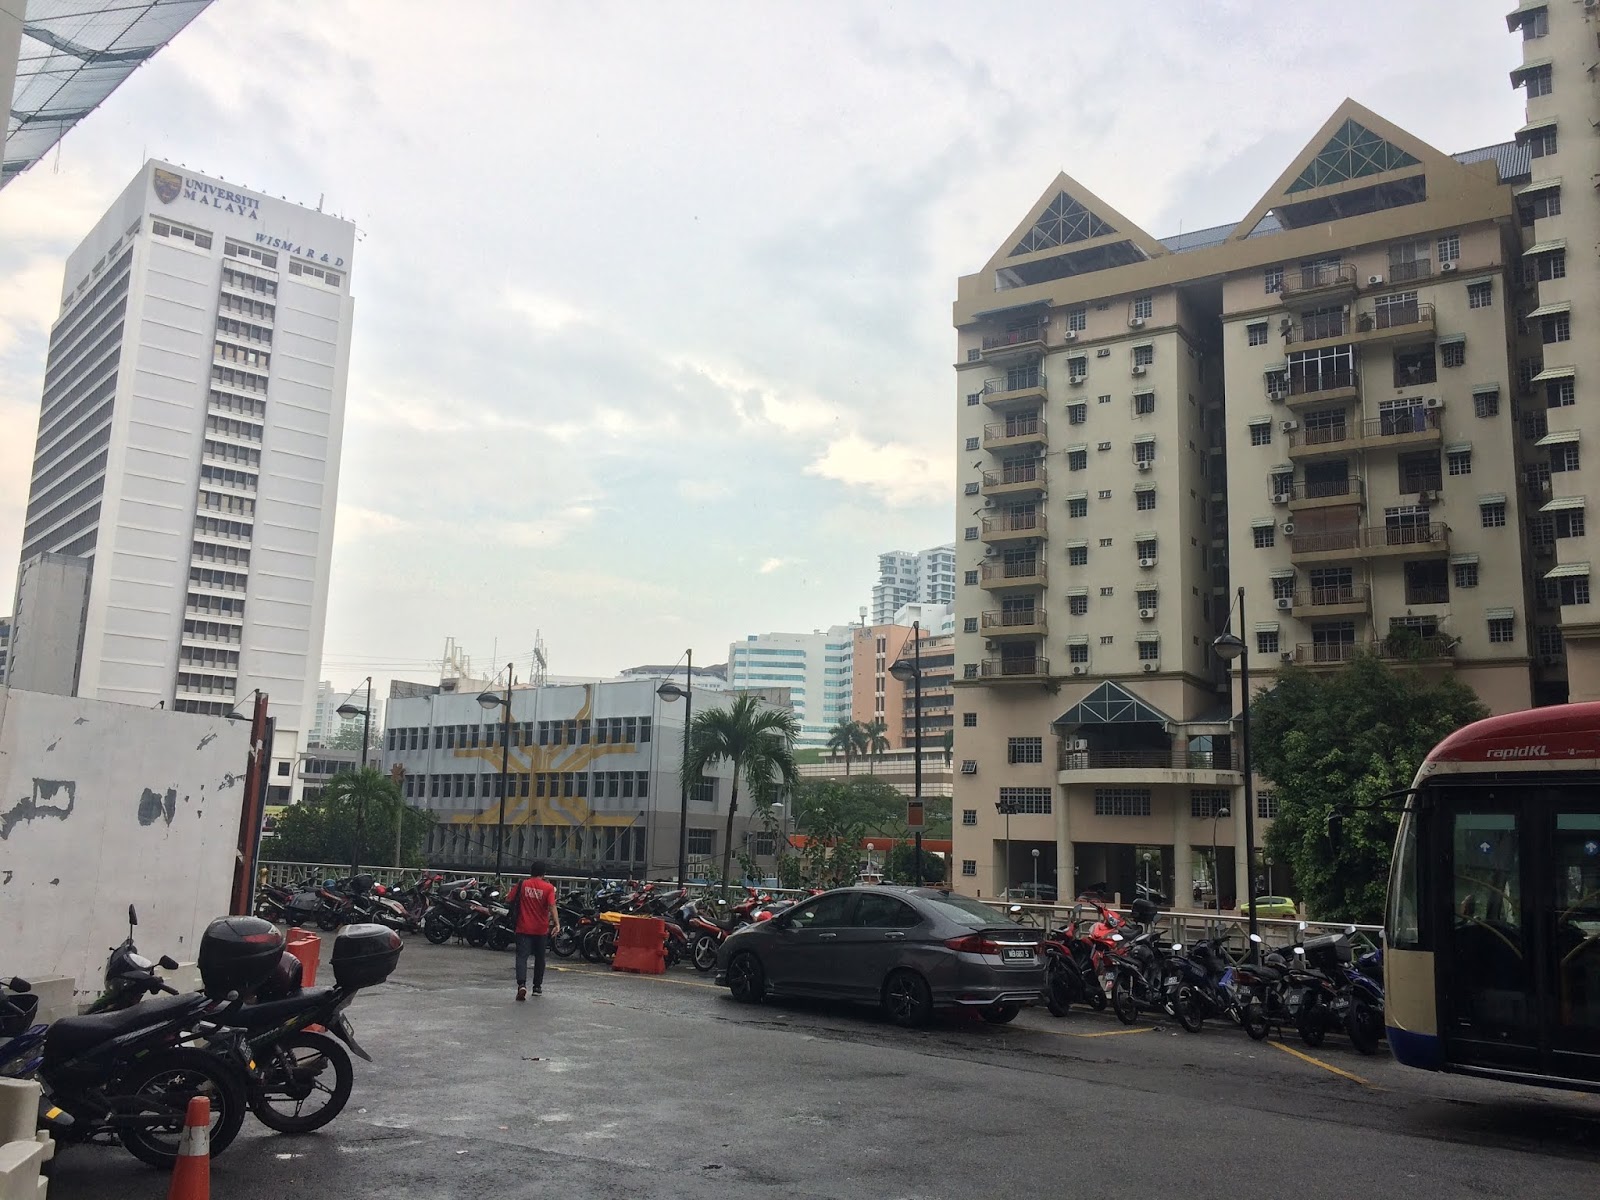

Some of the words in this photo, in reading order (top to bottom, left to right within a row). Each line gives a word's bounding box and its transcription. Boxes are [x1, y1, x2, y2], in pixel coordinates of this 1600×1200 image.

[184, 189, 258, 220] MALAYA
[185, 178, 259, 209] UNIVERSITI
[256, 232, 301, 255] WISMA
[306, 249, 315, 258] R
[320, 253, 329, 263] &
[335, 256, 344, 267] D
[1486, 745, 1550, 760] rapidKL
